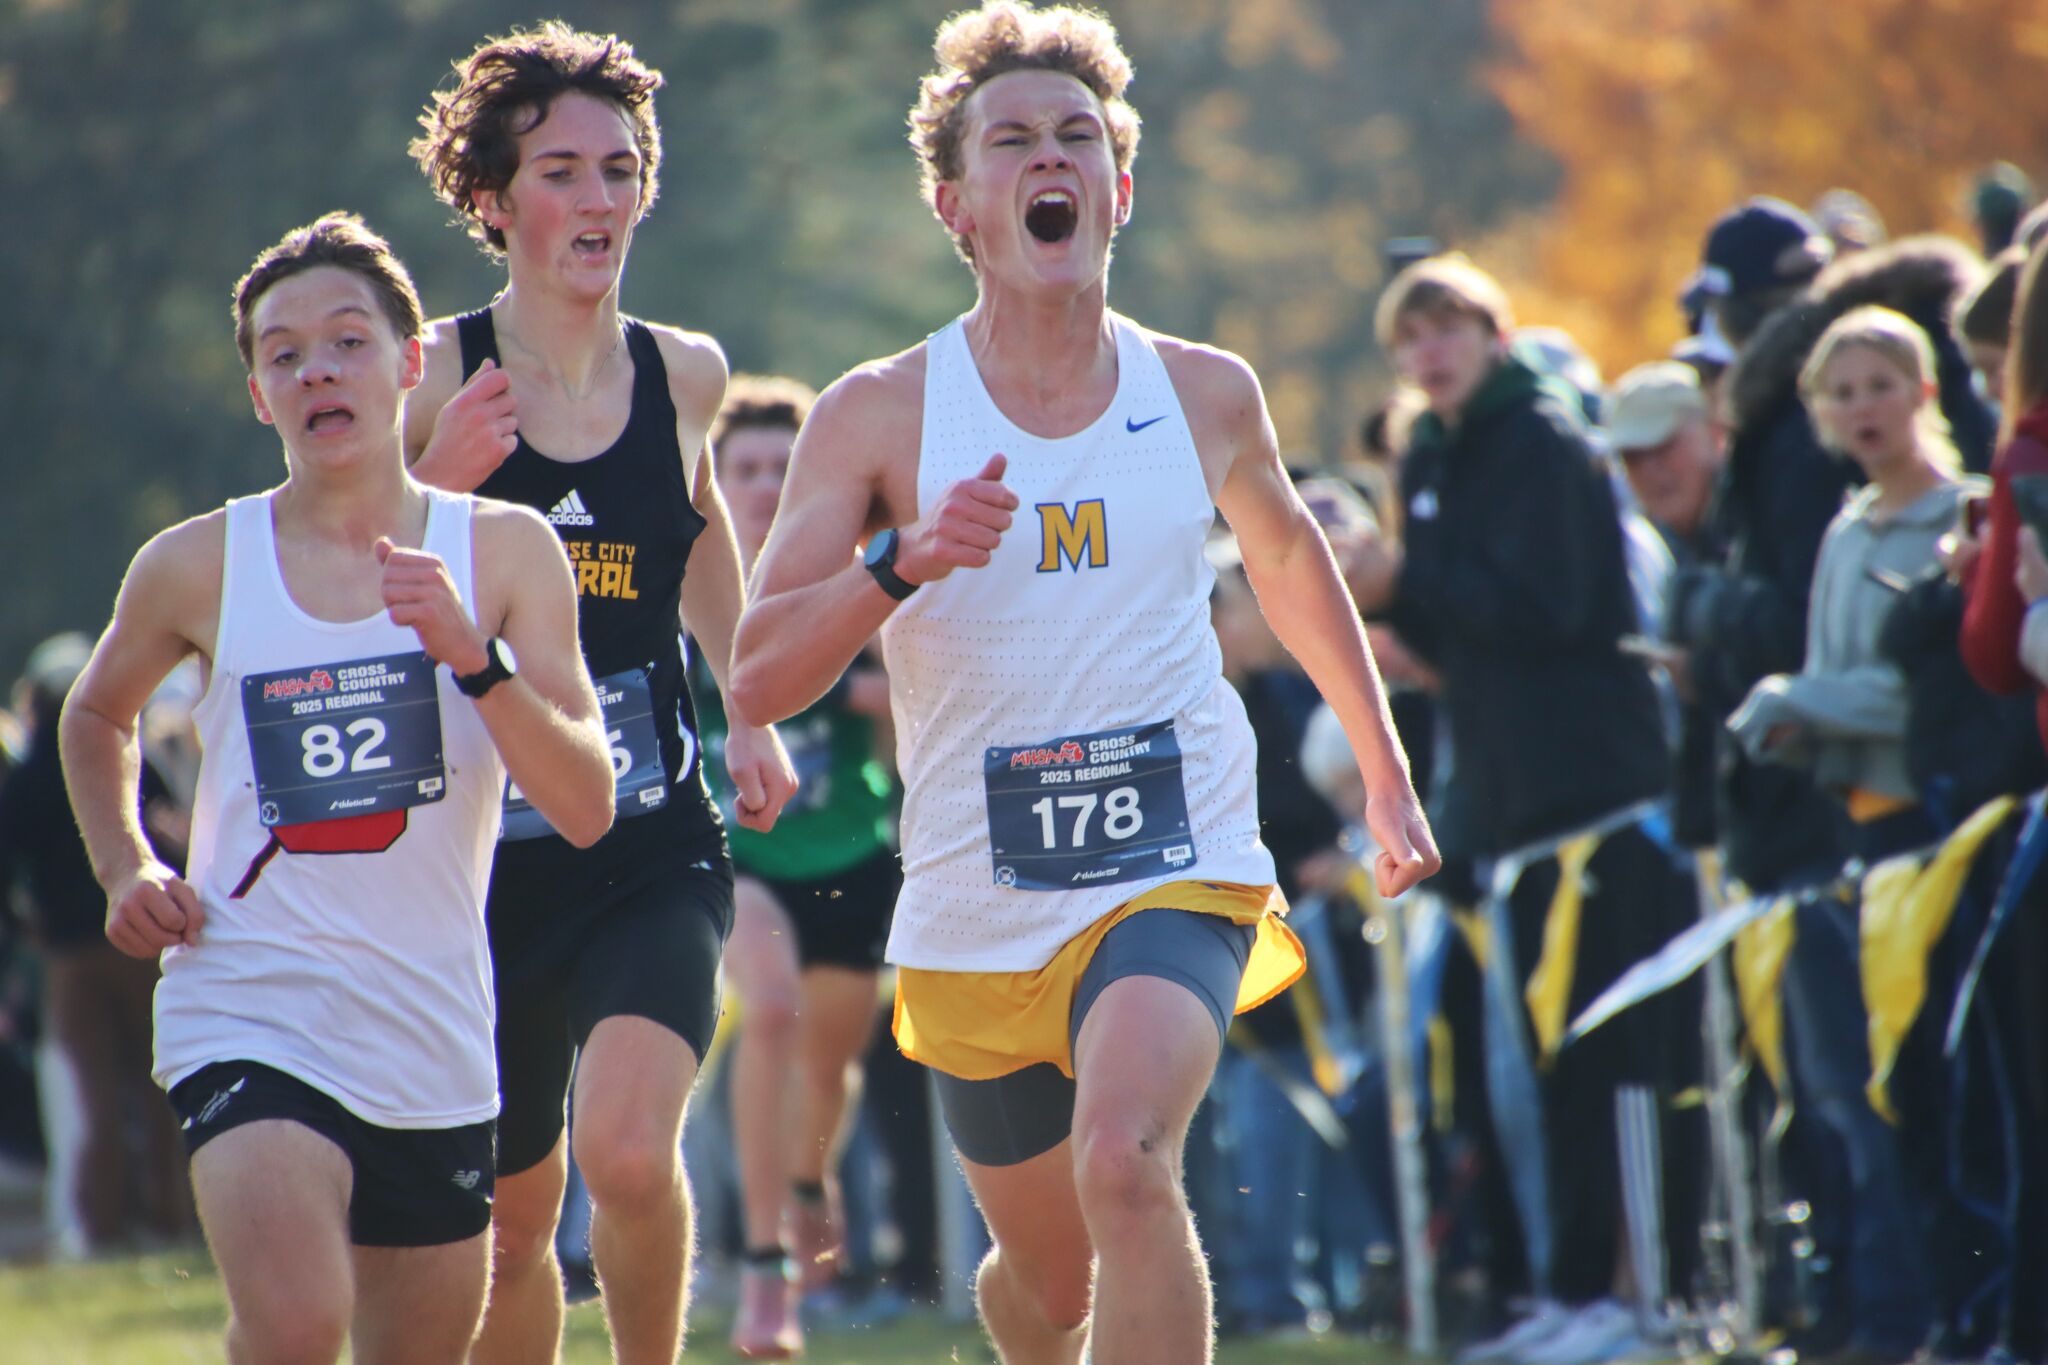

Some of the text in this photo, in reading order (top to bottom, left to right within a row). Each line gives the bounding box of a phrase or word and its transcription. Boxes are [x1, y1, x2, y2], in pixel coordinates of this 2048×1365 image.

[546, 511, 593, 525] adidas
[1035, 498, 1108, 573] M
[599, 543, 635, 562] CITY
[337, 663, 386, 681] CROSS
[339, 672, 406, 692] COUNTRY
[292, 699, 322, 715] 2025
[325, 691, 384, 710] REGIONAL
[301, 717, 391, 778] 82
[1088, 734, 1136, 752] CROSS
[1089, 741, 1151, 764] COUNTRY
[1040, 771, 1072, 784] 2025
[1075, 761, 1132, 782] REGIONAL
[1032, 786, 1143, 849] 178
